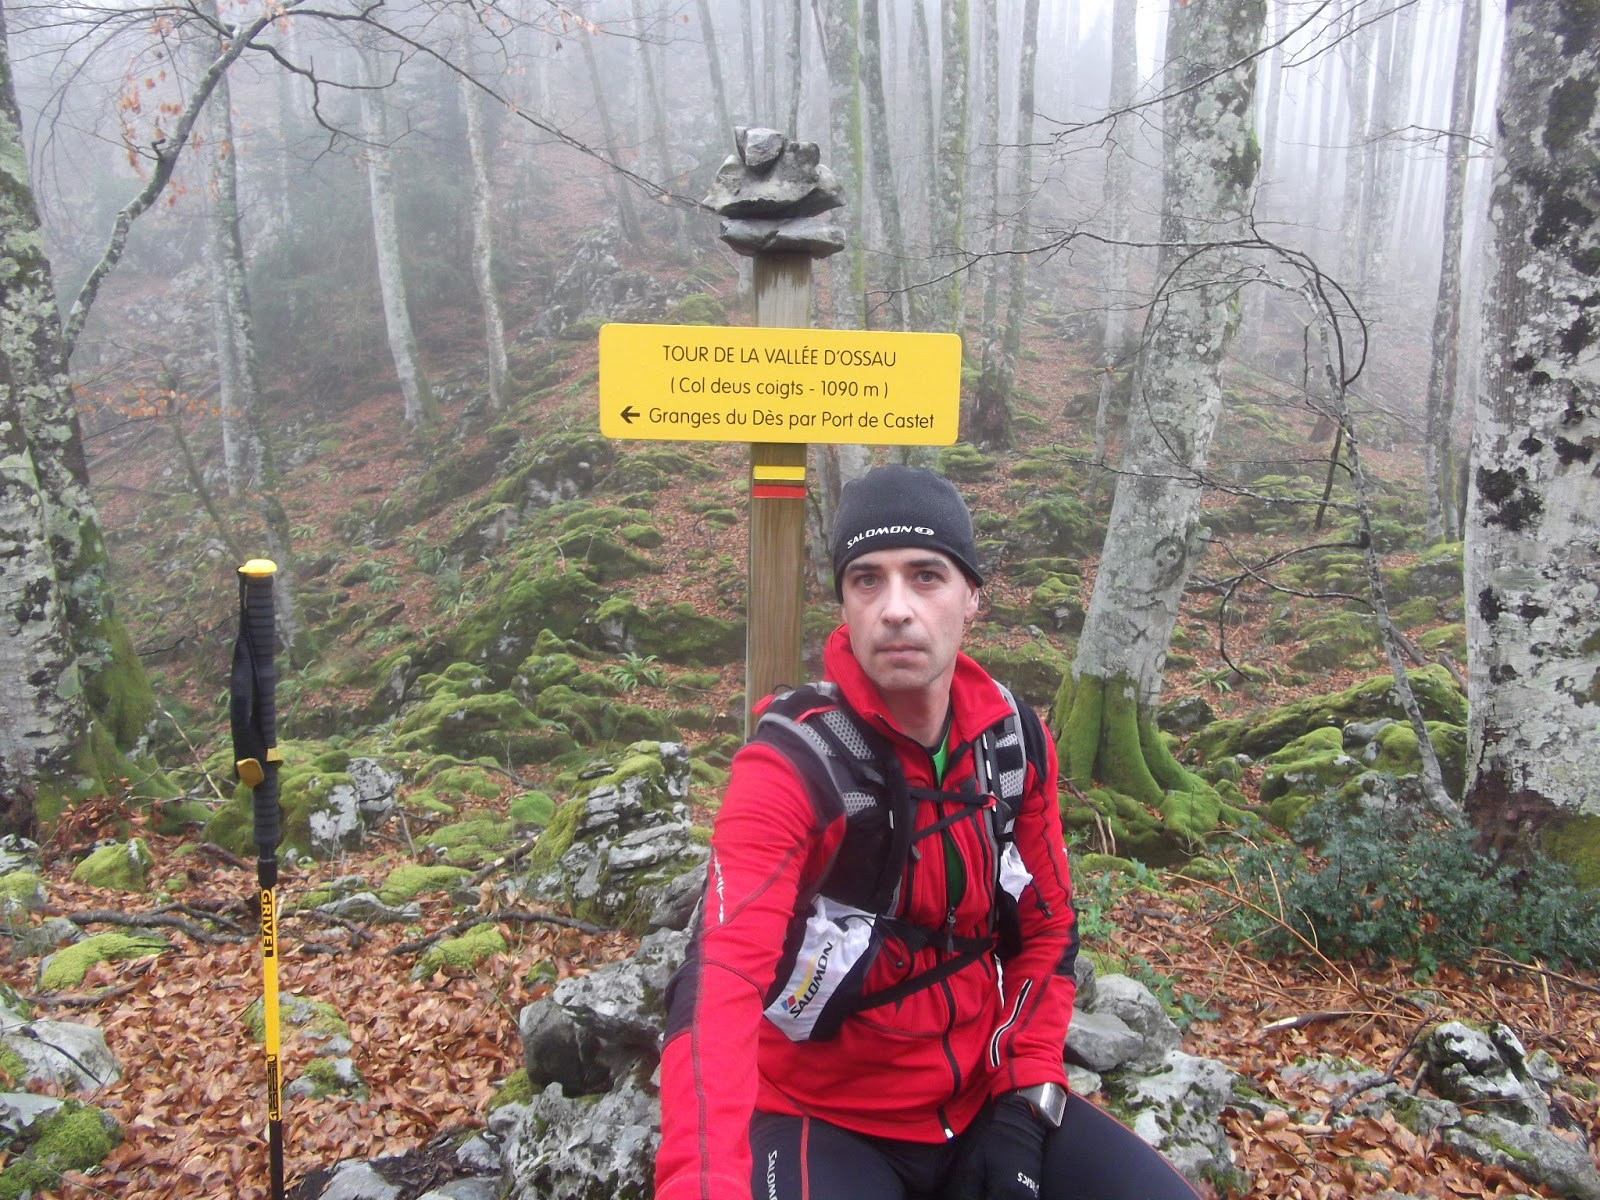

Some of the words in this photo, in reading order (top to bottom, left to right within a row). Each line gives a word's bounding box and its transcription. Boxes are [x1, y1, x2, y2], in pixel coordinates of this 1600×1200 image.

[662, 345, 708, 362] TOUR
[714, 346, 735, 363] DE
[740, 347, 760, 363] LA
[764, 345, 819, 365] VALLÉE
[824, 349, 897, 367] D'OSSAU
[710, 377, 751, 394] deus
[756, 379, 804, 399] coigts
[821, 380, 859, 397] 1090
[648, 407, 721, 428] Granges
[725, 408, 747, 425] du
[752, 409, 784, 426] Dès
[789, 413, 817, 430] par
[821, 411, 853, 427] Port
[857, 411, 879, 428] de
[883, 412, 935, 429] Castet
[846, 525, 913, 550] SALOMON
[262, 889, 273, 955] GRIVEL
[789, 941, 833, 1019] SALOMON
